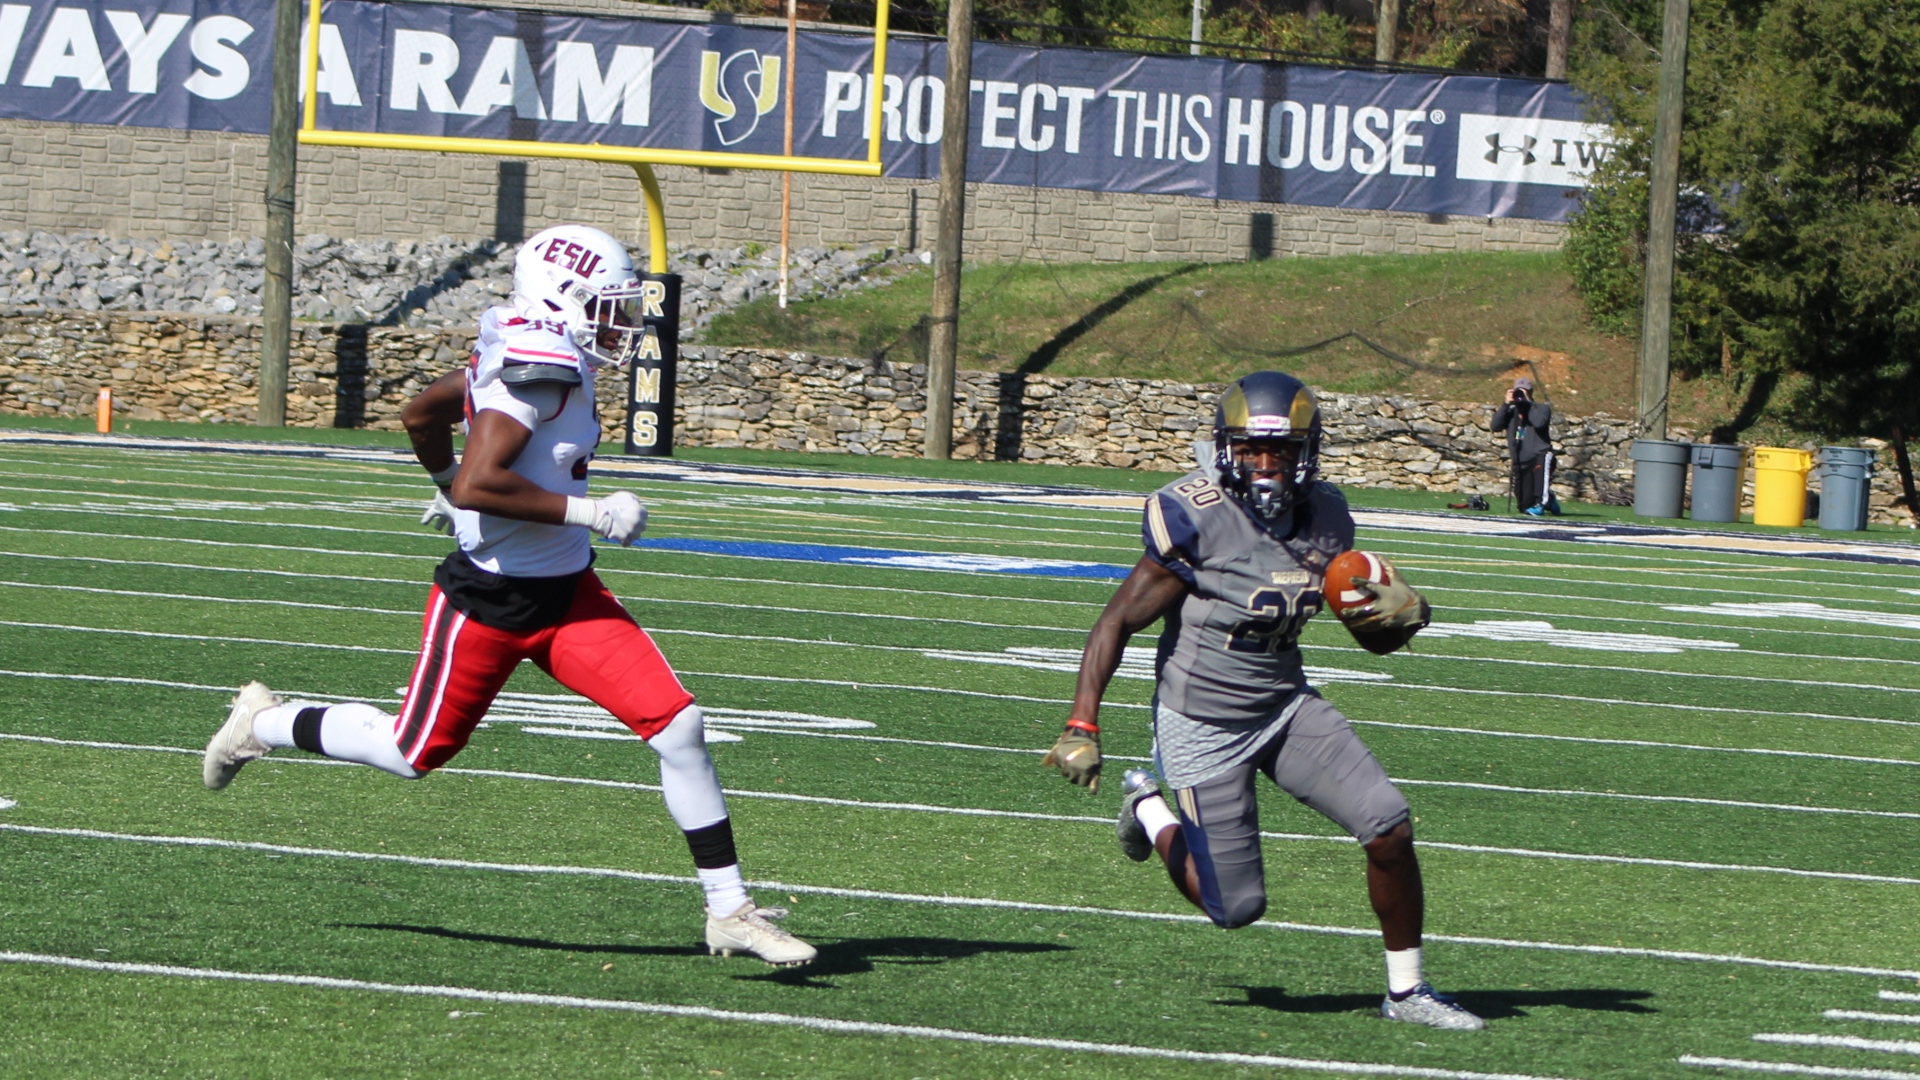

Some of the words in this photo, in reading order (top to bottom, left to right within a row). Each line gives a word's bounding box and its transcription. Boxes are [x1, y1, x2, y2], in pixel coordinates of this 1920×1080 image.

[299, 23, 363, 107] A
[390, 29, 654, 127] RAM
[1108, 90, 1213, 163] THIS
[543, 238, 602, 280] ESU
[1173, 476, 1224, 510] 20
[1223, 586, 1323, 654] 20
